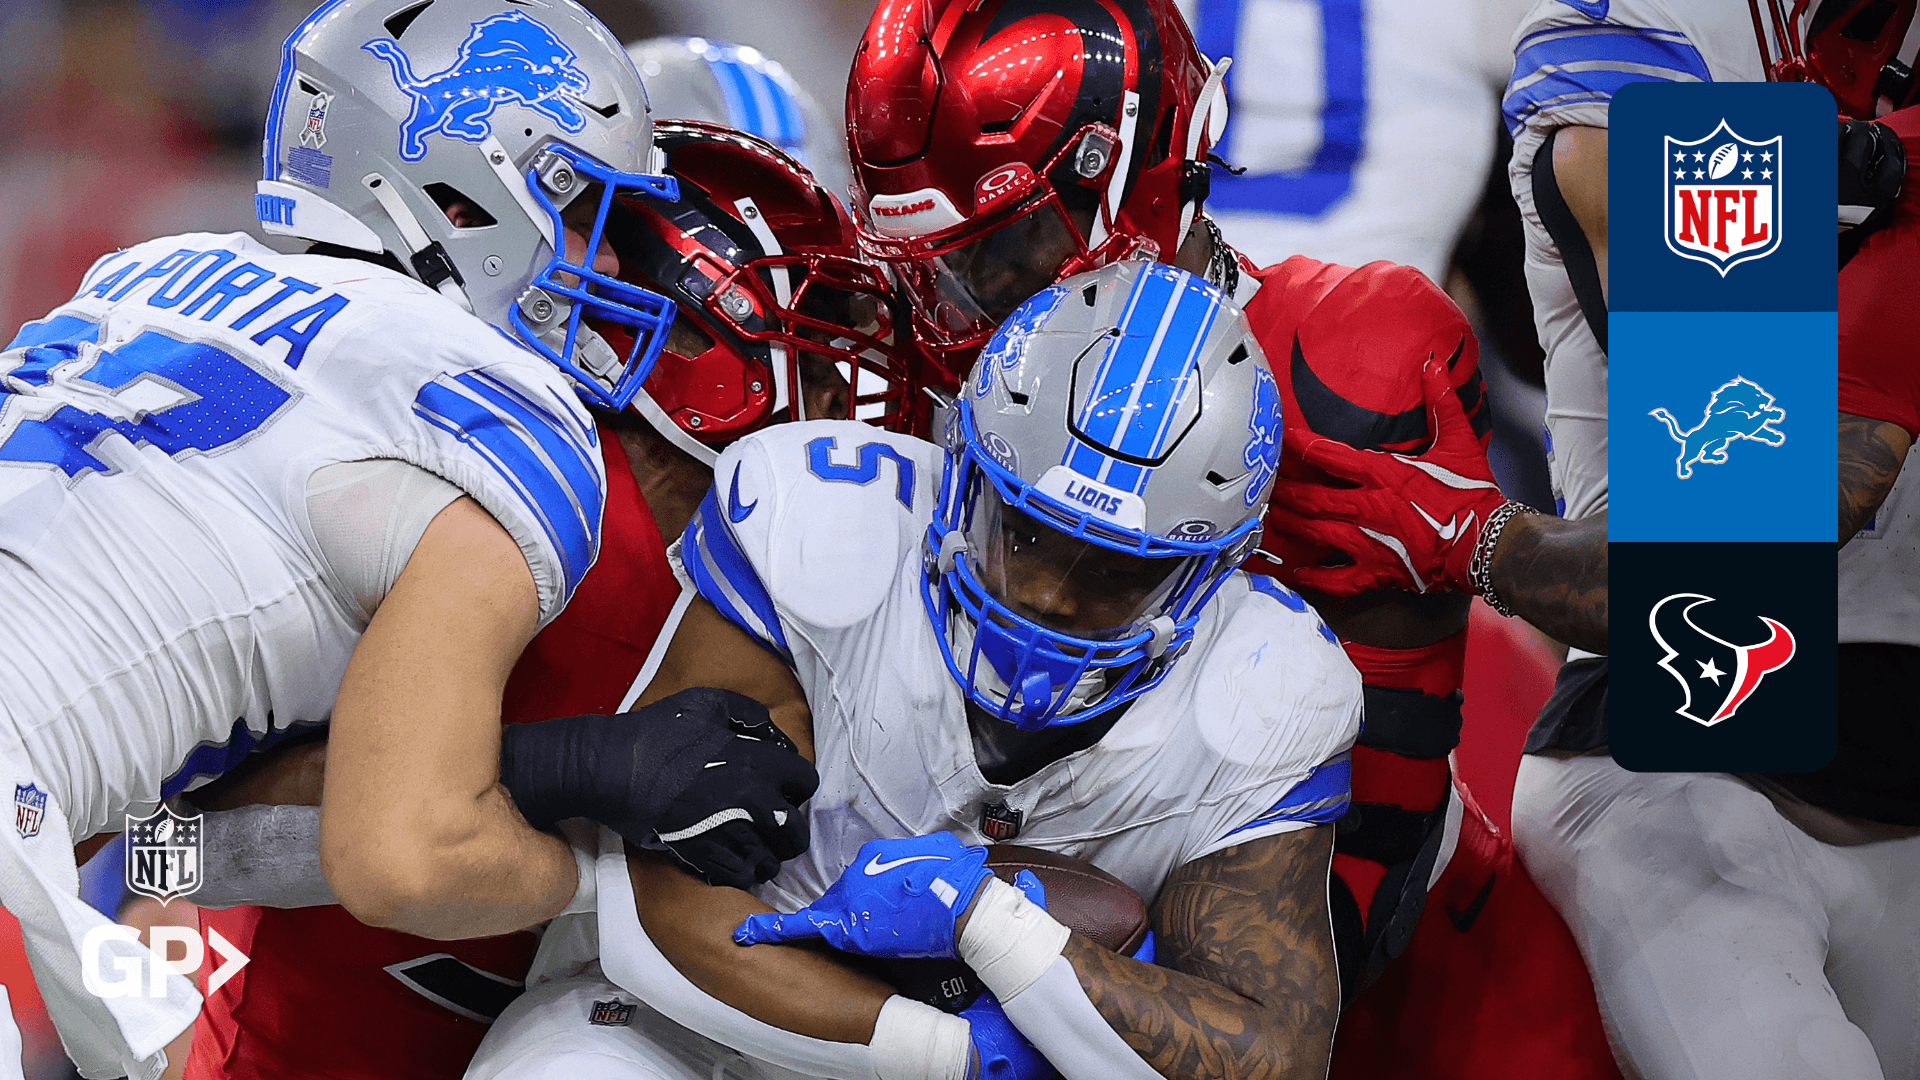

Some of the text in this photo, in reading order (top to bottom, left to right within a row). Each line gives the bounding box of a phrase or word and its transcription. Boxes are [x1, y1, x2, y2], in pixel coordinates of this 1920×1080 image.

[978, 172, 1030, 204] OAKLEY
[872, 199, 936, 216] TEXANS
[983, 439, 1015, 472] OAKLEY
[804, 436, 916, 514] 5
[1064, 480, 1123, 515] LIONS
[1169, 534, 1211, 542] OAKLEY
[16, 804, 39, 834] NFL
[986, 819, 1013, 838] NFL
[595, 1010, 627, 1022] NFL
